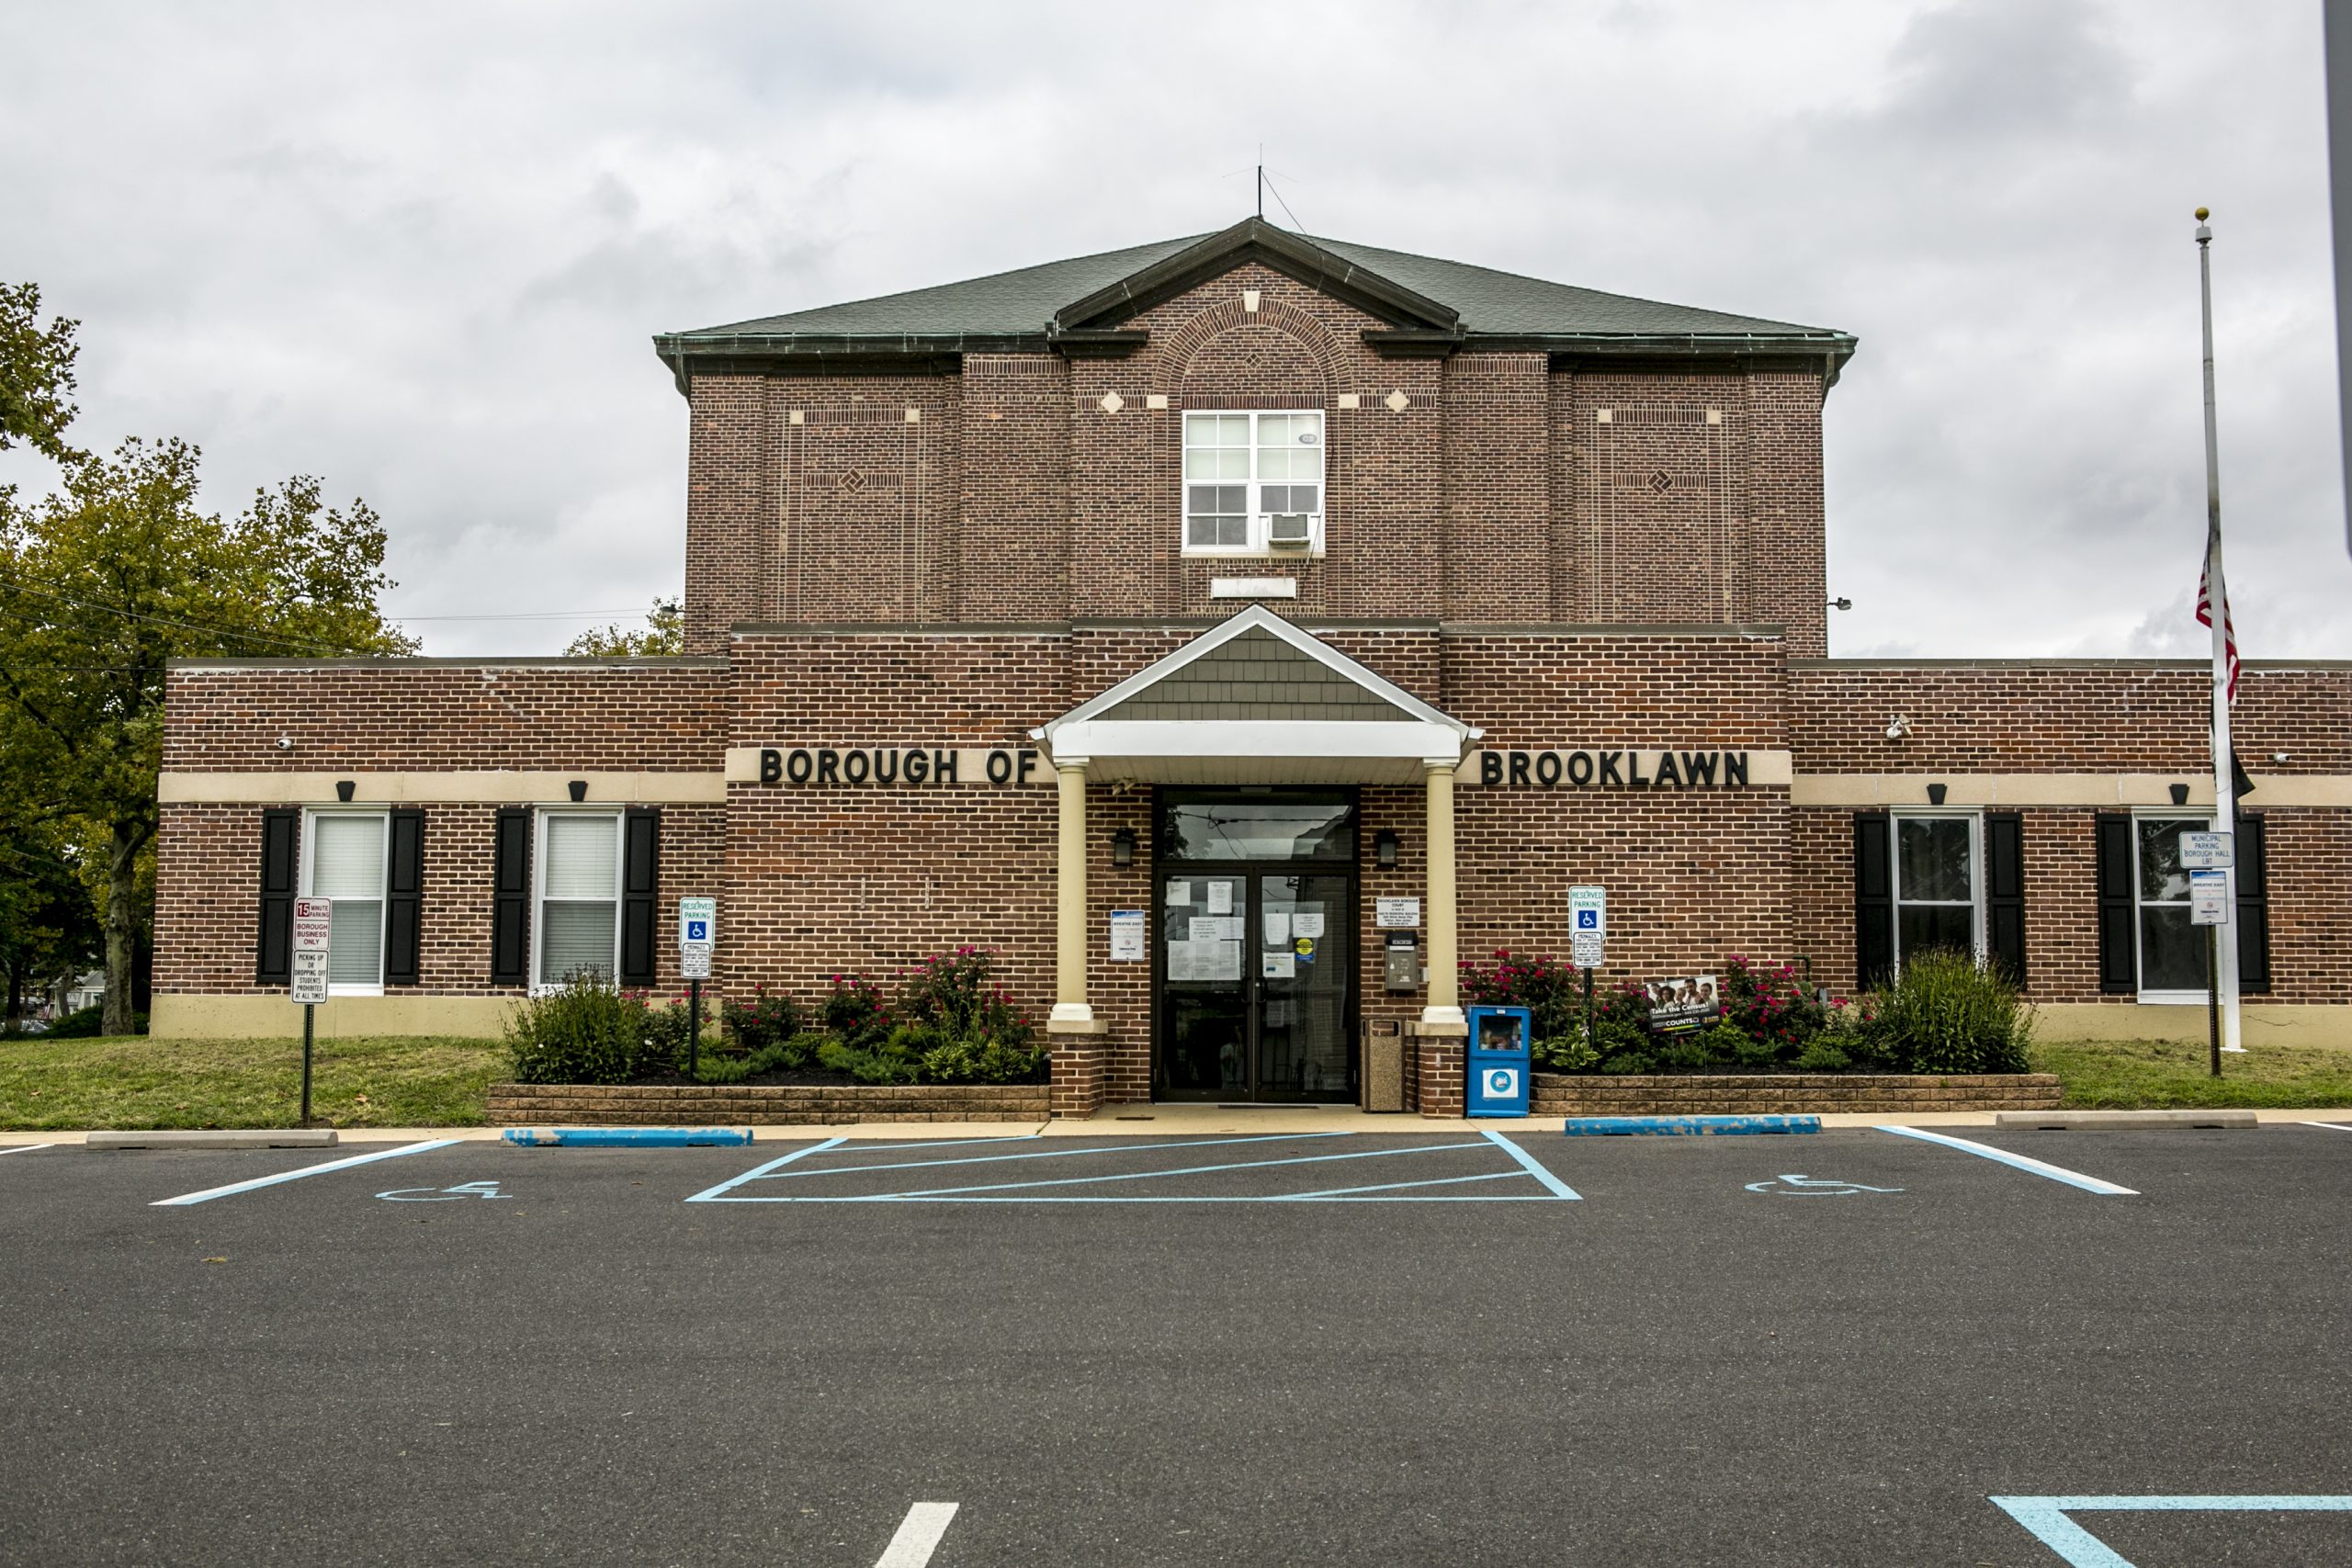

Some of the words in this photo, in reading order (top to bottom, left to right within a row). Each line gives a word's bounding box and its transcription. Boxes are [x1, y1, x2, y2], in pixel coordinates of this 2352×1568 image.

[761, 749, 957, 783] BOROUGH
[986, 749, 1038, 784] OF
[1480, 750, 1749, 785] BROOKLAWN
[1572, 891, 1603, 899] RESERVED
[299, 904, 310, 917] 15
[1681, 1002, 1709, 1010] Census!
[1666, 1018, 1692, 1027] COUNTS
